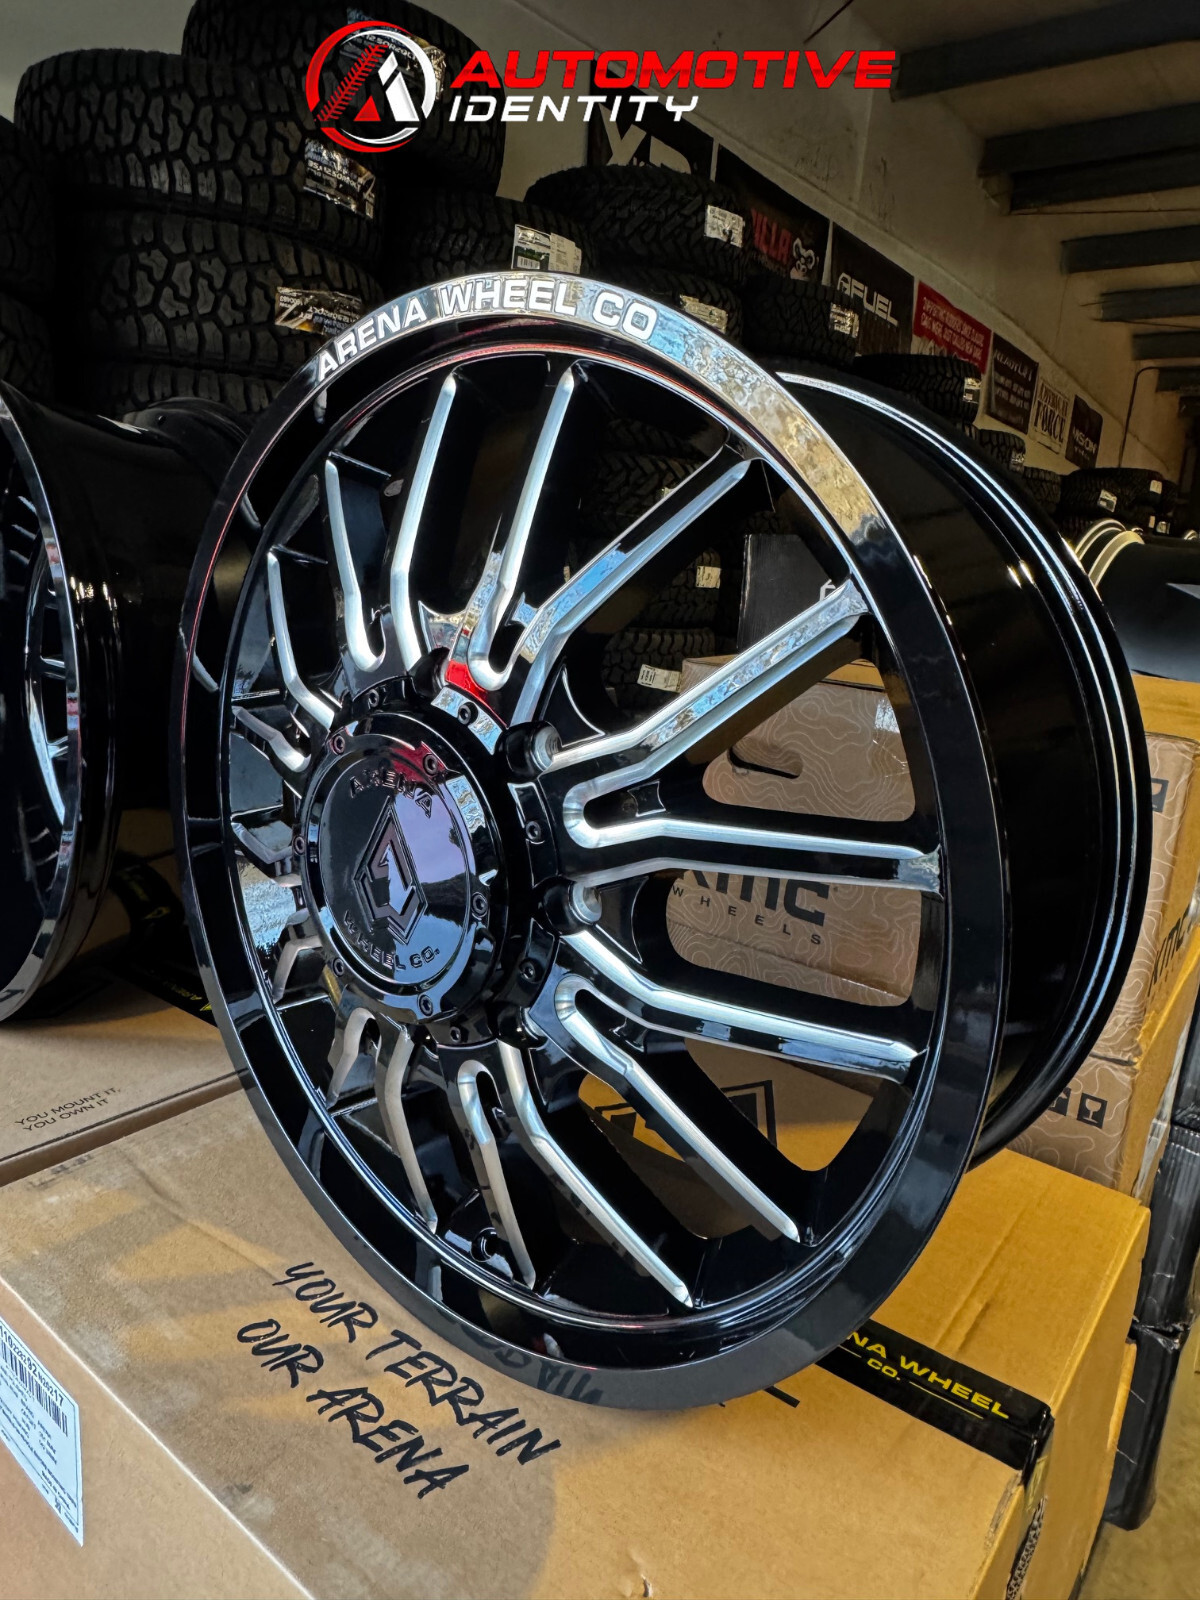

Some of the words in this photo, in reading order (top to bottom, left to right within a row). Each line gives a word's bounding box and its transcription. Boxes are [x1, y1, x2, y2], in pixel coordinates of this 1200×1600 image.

[317, 297, 428, 382] ARENA
[440, 279, 578, 316] WHEEL
[592, 291, 657, 340] CO
[350, 768, 433, 819] ARENA
[672, 886, 822, 945] WHEELS
[15, 1111, 49, 1126] YOU
[51, 1092, 101, 1114] MOUNT
[22, 1117, 57, 1132] YOU
[59, 1104, 95, 1120] OWN
[97, 1098, 110, 1107] IT
[272, 1261, 379, 1343] YOUR
[366, 1329, 562, 1465] TERRAIN
[848, 1331, 887, 1359] NA
[899, 1354, 1010, 1419] WHEEL
[867, 1358, 901, 1381] CO.
[236, 1318, 324, 1389] OUR
[306, 1386, 470, 1499] ARENA
